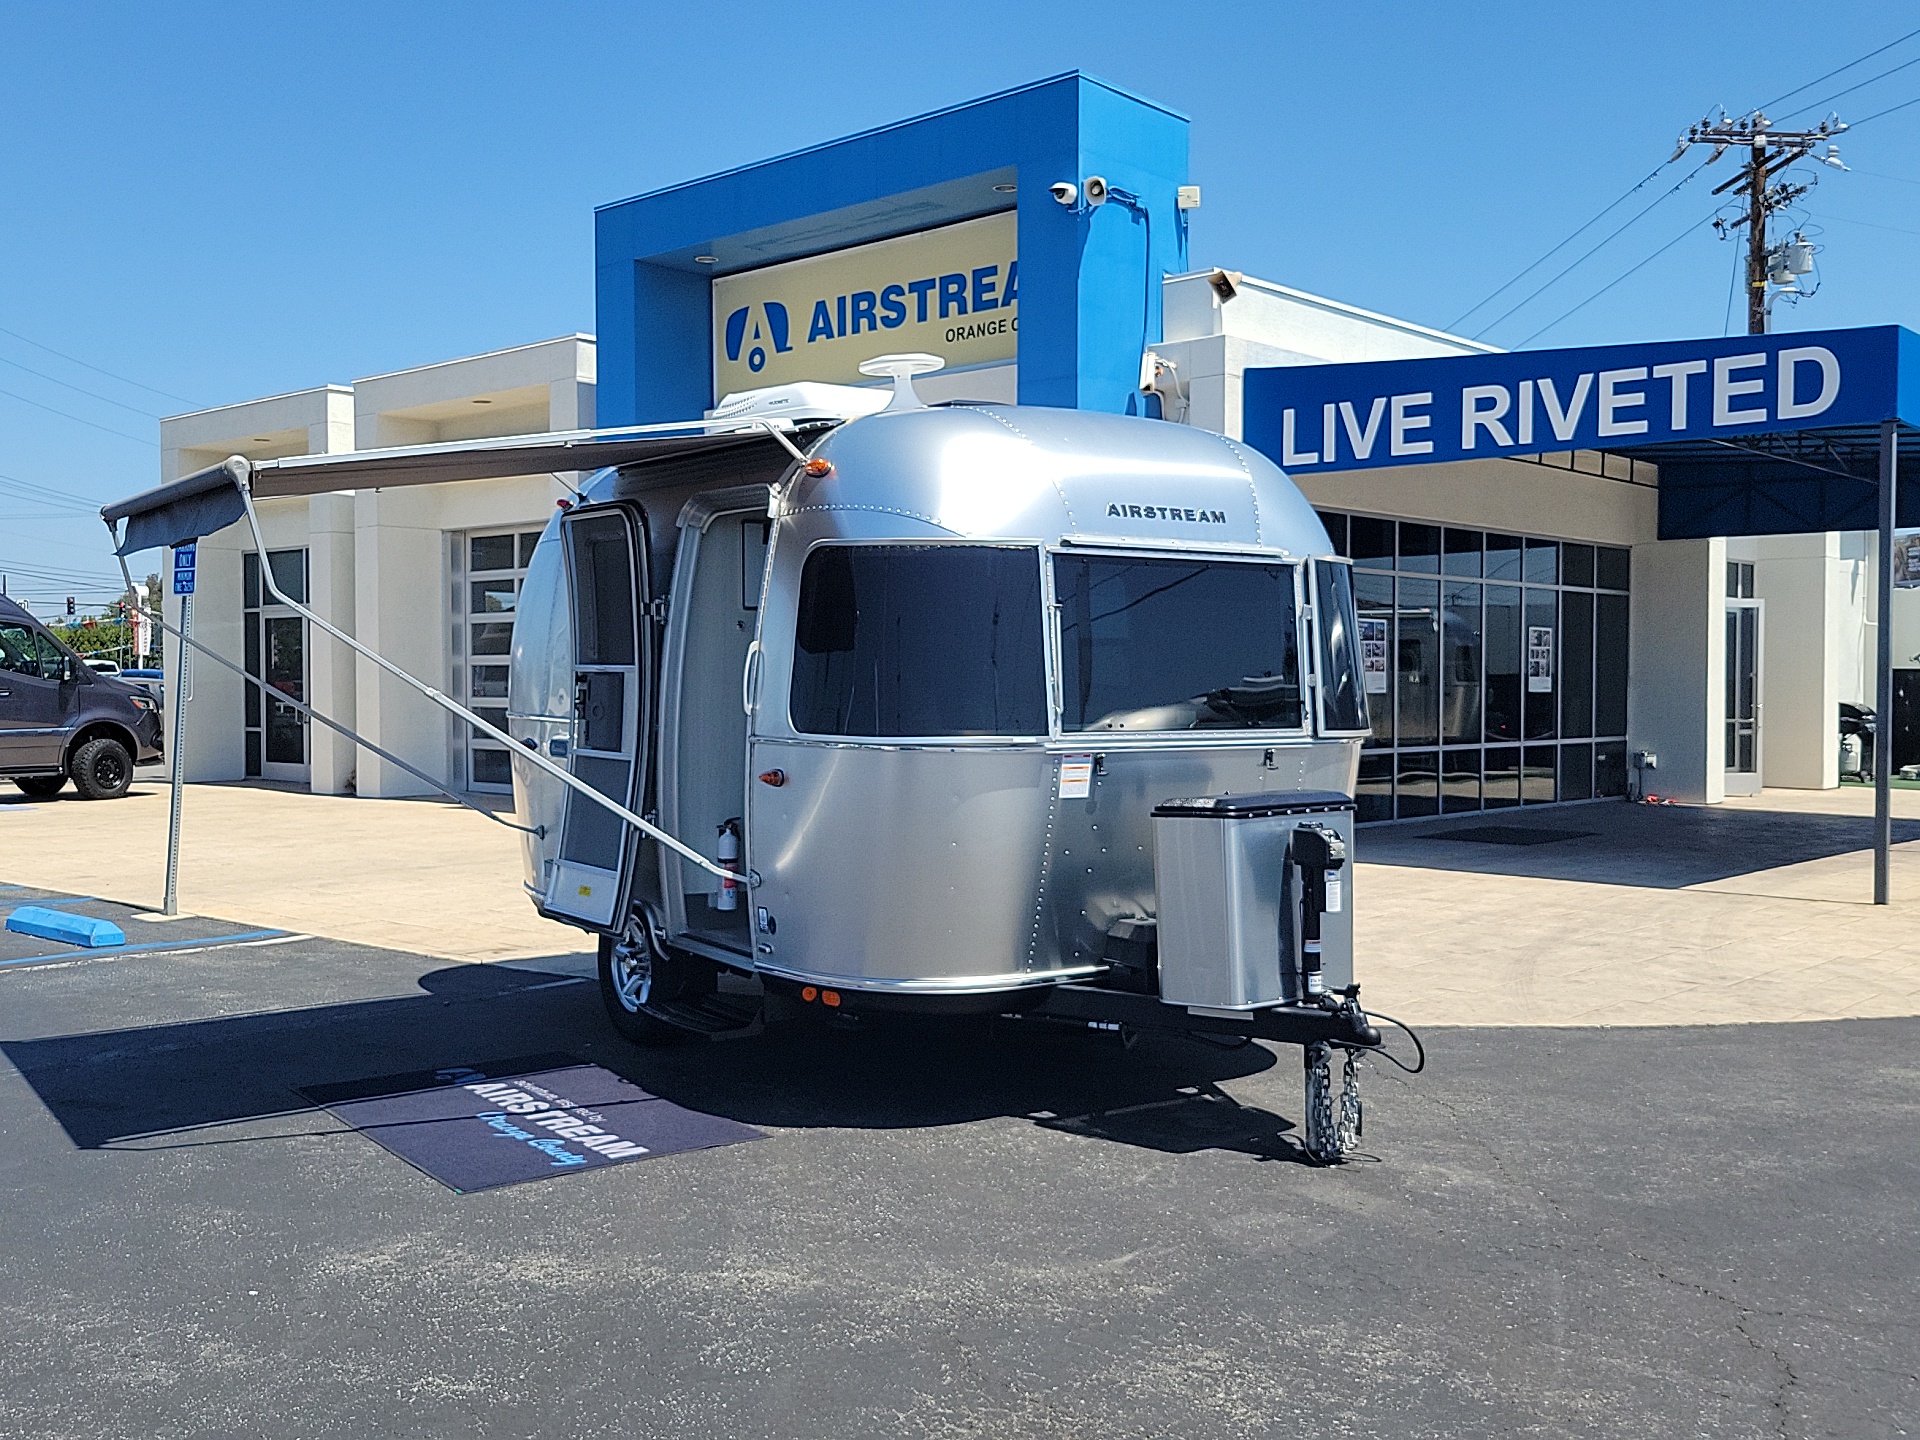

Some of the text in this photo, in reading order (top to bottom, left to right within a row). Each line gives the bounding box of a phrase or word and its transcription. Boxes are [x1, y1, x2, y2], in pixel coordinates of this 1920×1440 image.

[945, 318, 1007, 342] ORANGE
[1282, 346, 1842, 467] LIVE RIVETED
[1106, 502, 1227, 524] AIRSTREAM
[463, 1082, 651, 1160] AIRSTREAM
